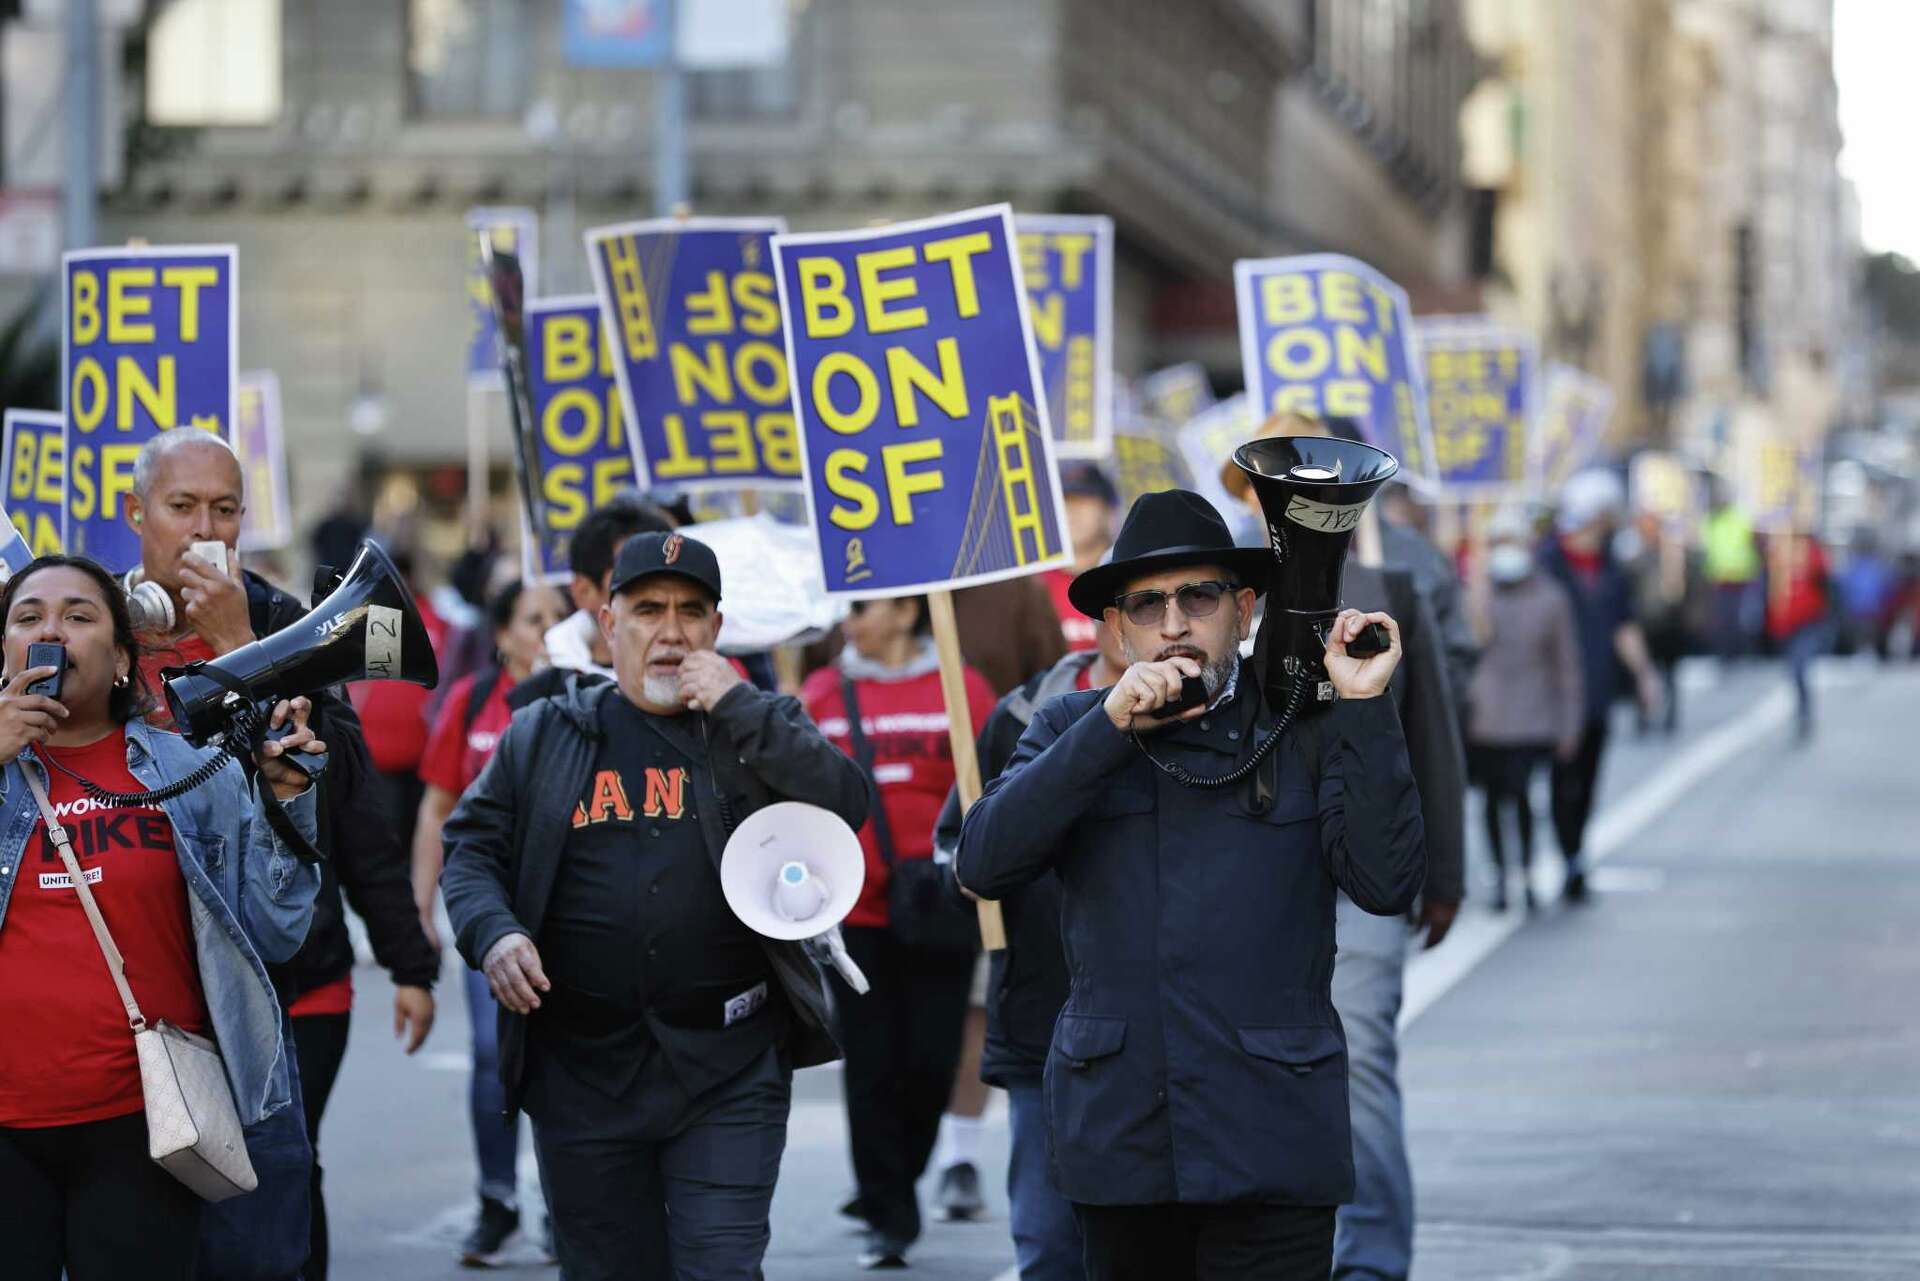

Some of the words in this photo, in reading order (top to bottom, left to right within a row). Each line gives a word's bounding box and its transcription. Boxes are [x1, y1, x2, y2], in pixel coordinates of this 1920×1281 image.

[72, 266, 218, 346] BET
[685, 271, 782, 337] SF
[798, 231, 993, 338] BET
[1262, 269, 1394, 335] BET
[669, 340, 792, 407] ON
[812, 337, 970, 435] ON
[1266, 323, 1389, 385] ON
[71, 355, 177, 434] ON
[70, 443, 142, 521] SF
[655, 411, 803, 478] BET
[543, 454, 633, 531] SF
[824, 438, 945, 531] SF
[571, 767, 686, 829] AN
